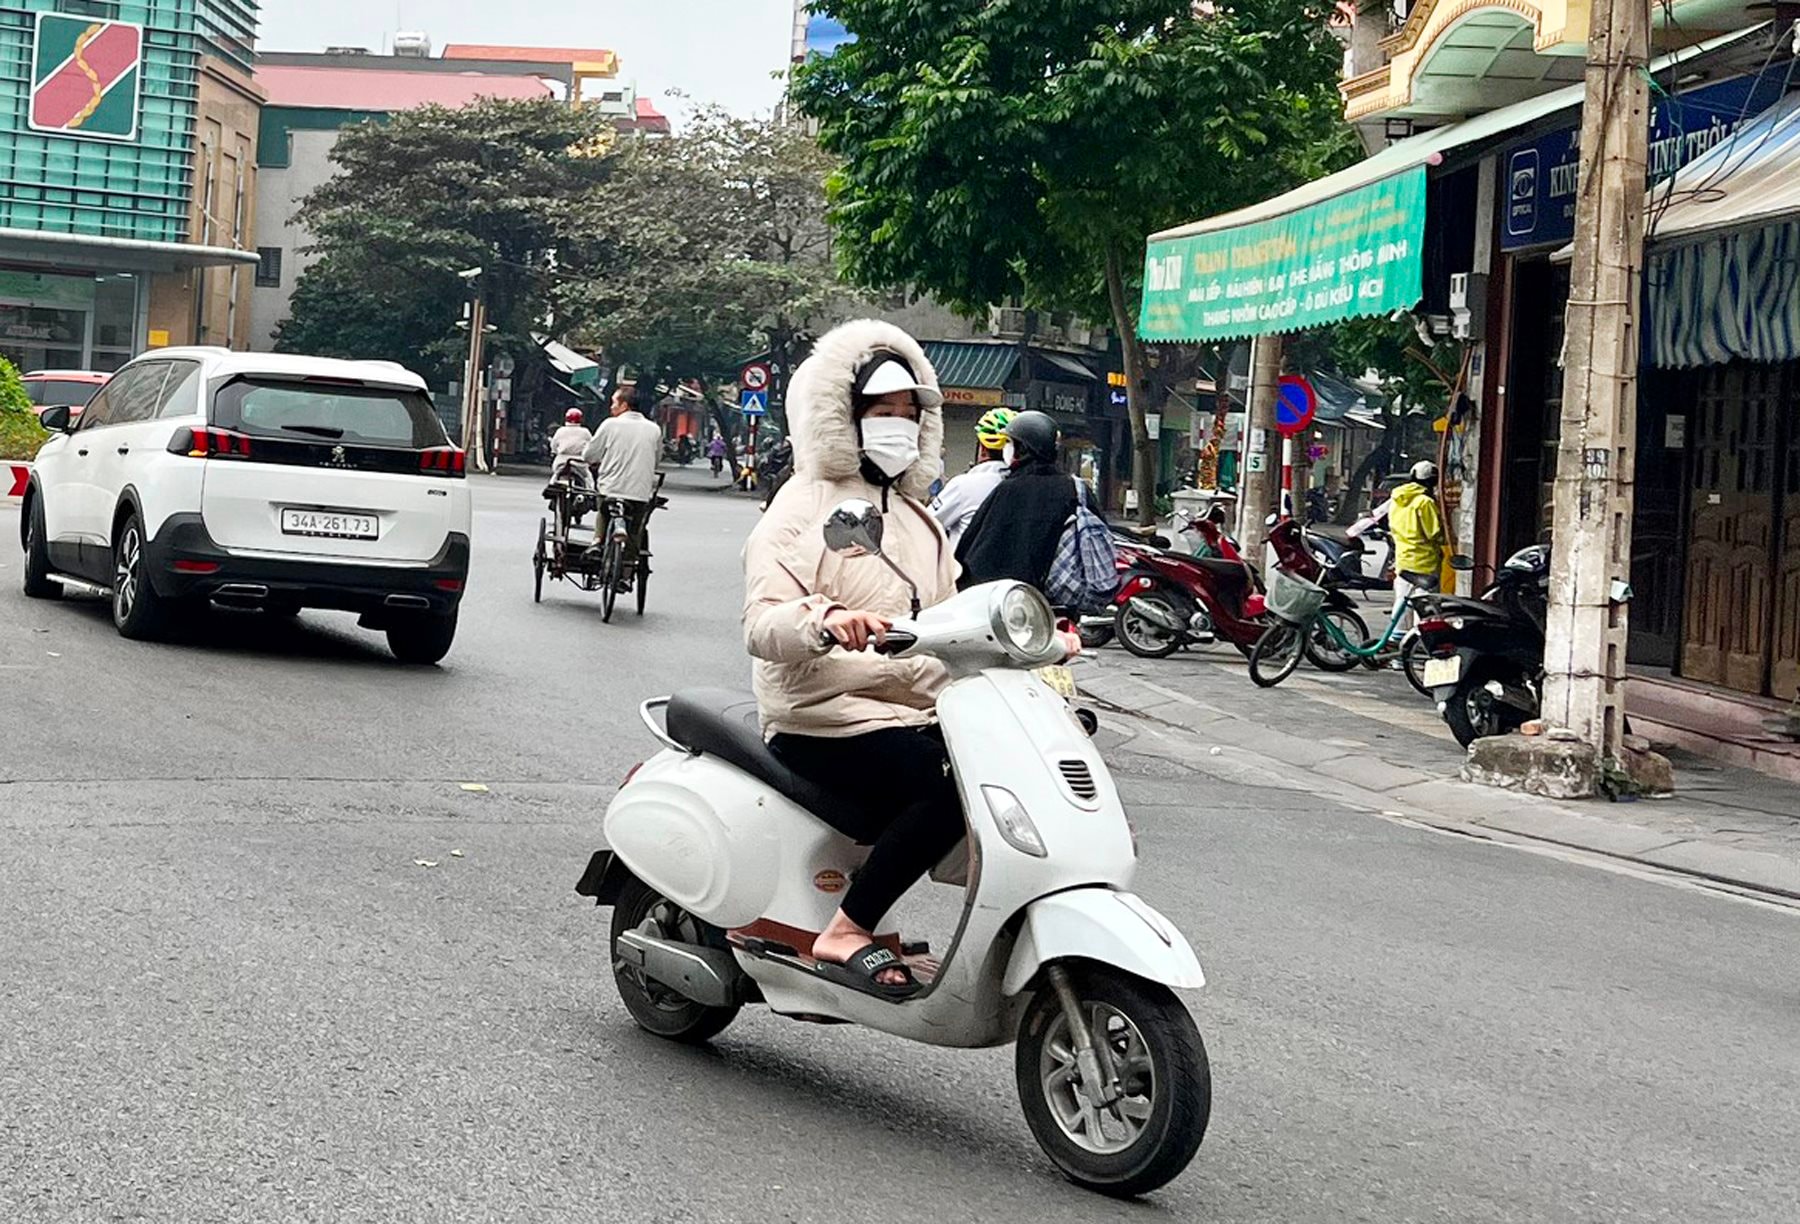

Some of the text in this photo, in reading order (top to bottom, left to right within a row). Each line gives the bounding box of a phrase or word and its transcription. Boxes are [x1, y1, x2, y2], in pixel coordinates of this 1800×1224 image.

[1648, 129, 1684, 176] ÍNH
[1339, 248, 1373, 275] THÔNG
[1377, 239, 1408, 265] MINH
[291, 513, 370, 532] 34A-261.73
